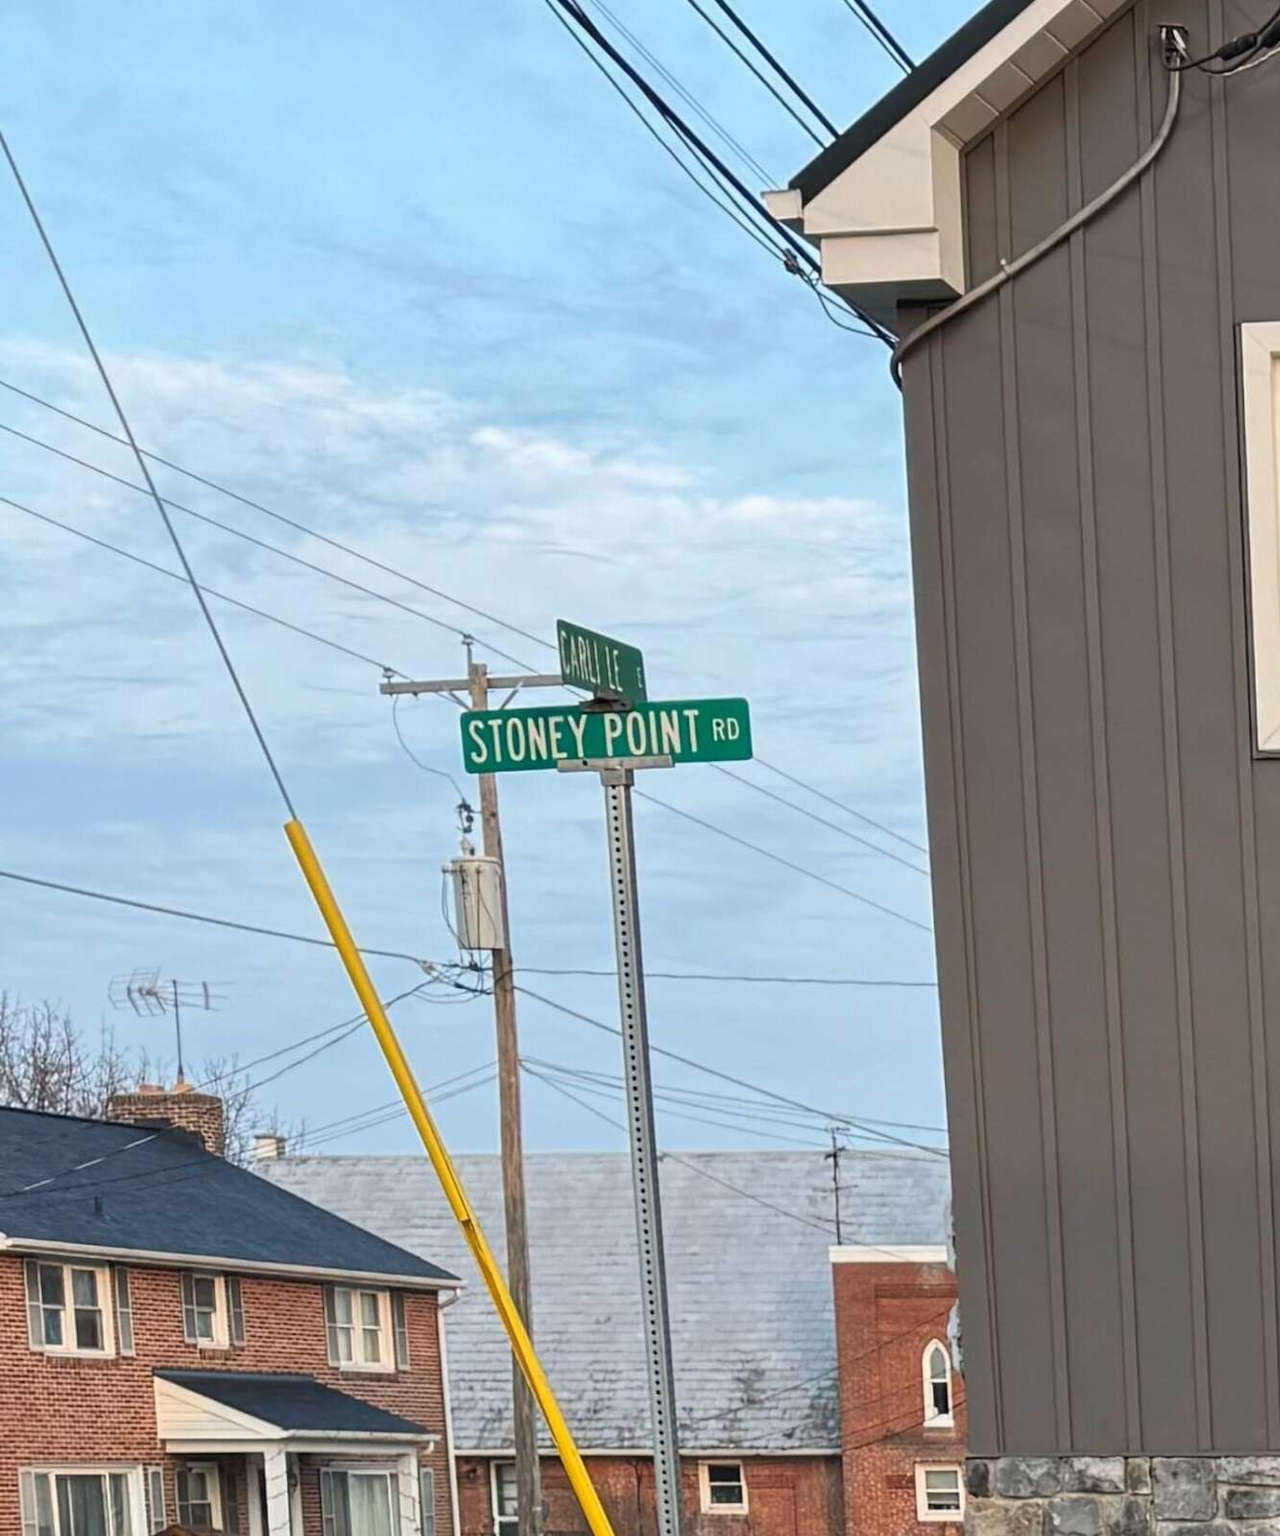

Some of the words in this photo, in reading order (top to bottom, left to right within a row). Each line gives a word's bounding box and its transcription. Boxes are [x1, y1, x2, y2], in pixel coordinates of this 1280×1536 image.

[469, 713, 587, 764] STONEY
[604, 709, 699, 757] POINT
[712, 717, 740, 742] RD
